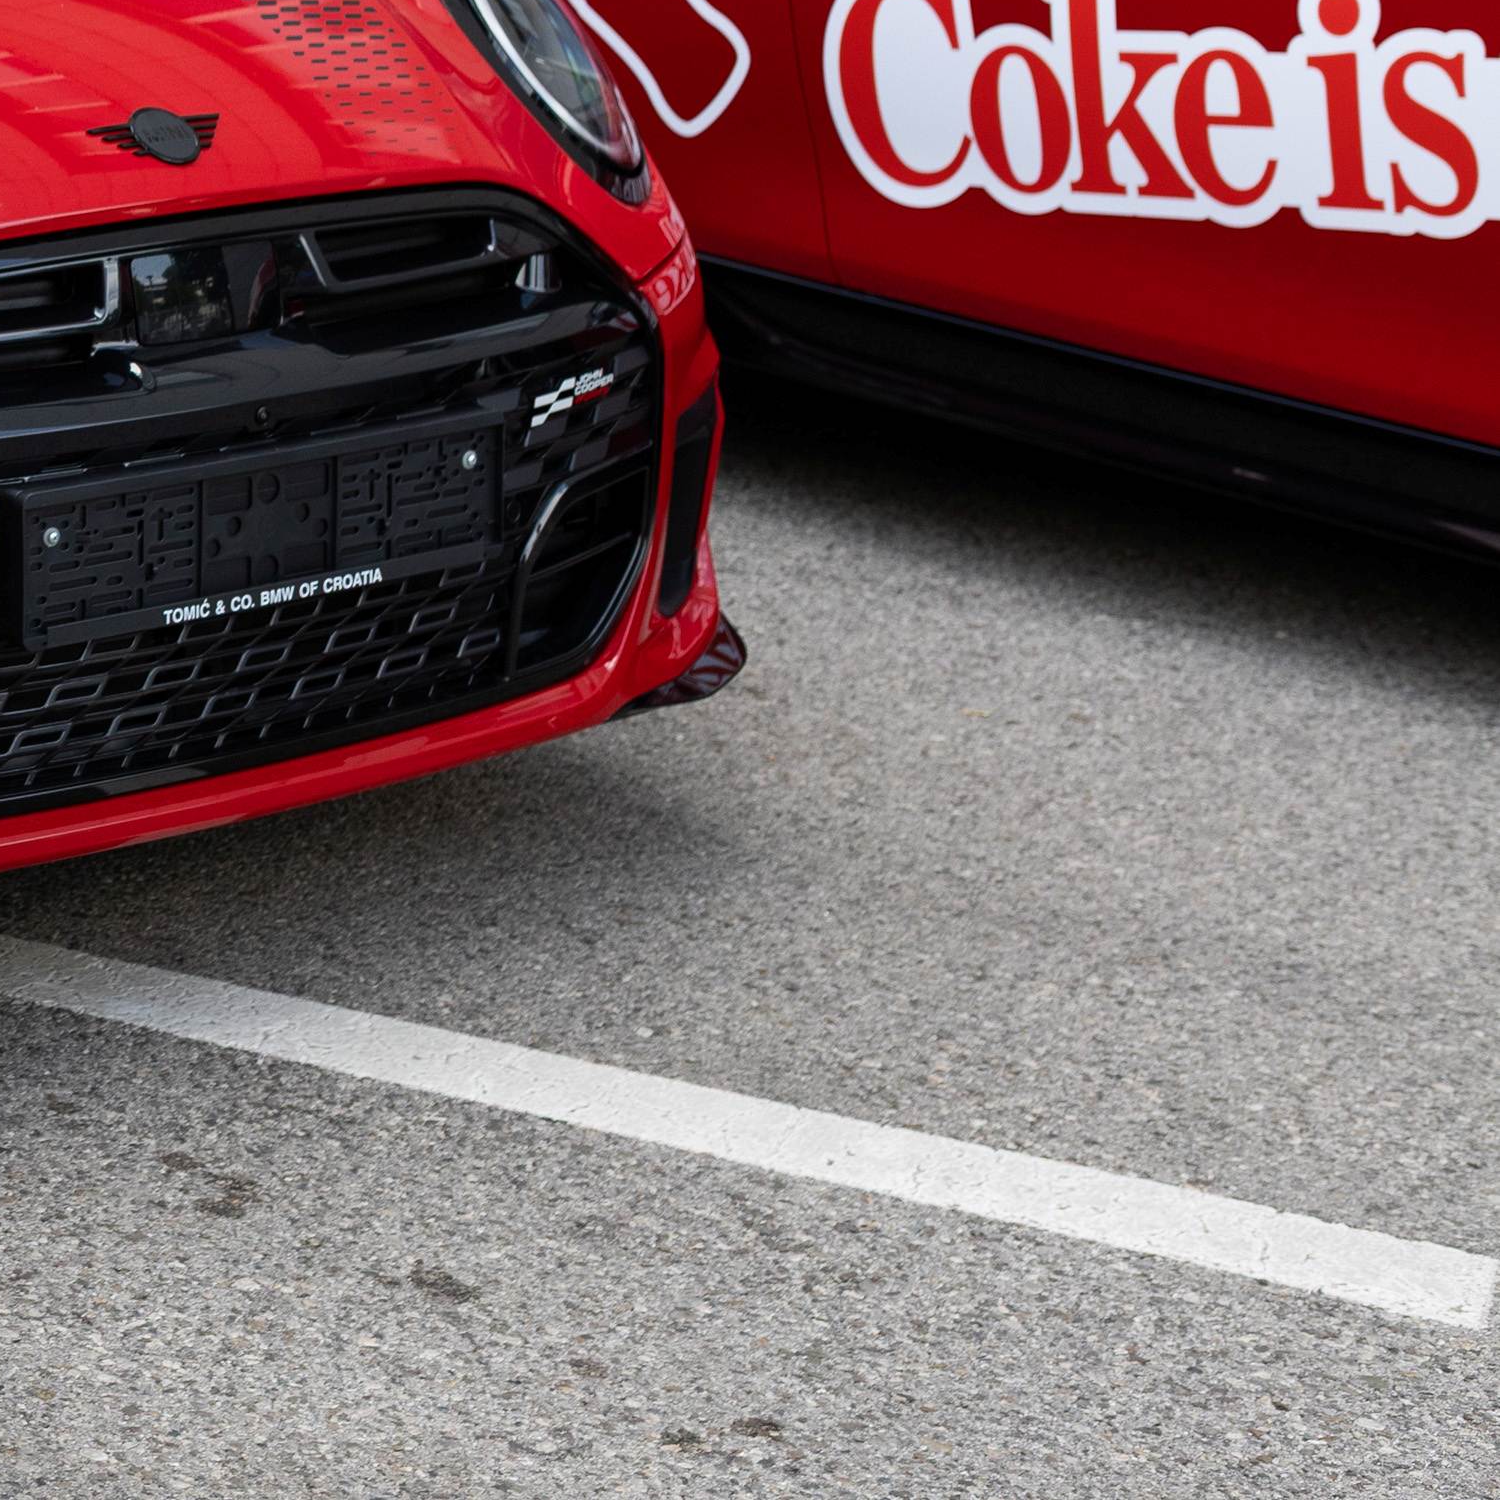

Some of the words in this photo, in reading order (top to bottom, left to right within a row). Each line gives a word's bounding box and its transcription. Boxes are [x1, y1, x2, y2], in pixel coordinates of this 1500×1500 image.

[162, 598, 209, 625] TOMIĆ
[214, 600, 226, 615] &
[230, 594, 256, 613] CO.
[260, 585, 295, 606] BMW
[299, 579, 319, 599] OF
[322, 567, 383, 594] CROATIA
